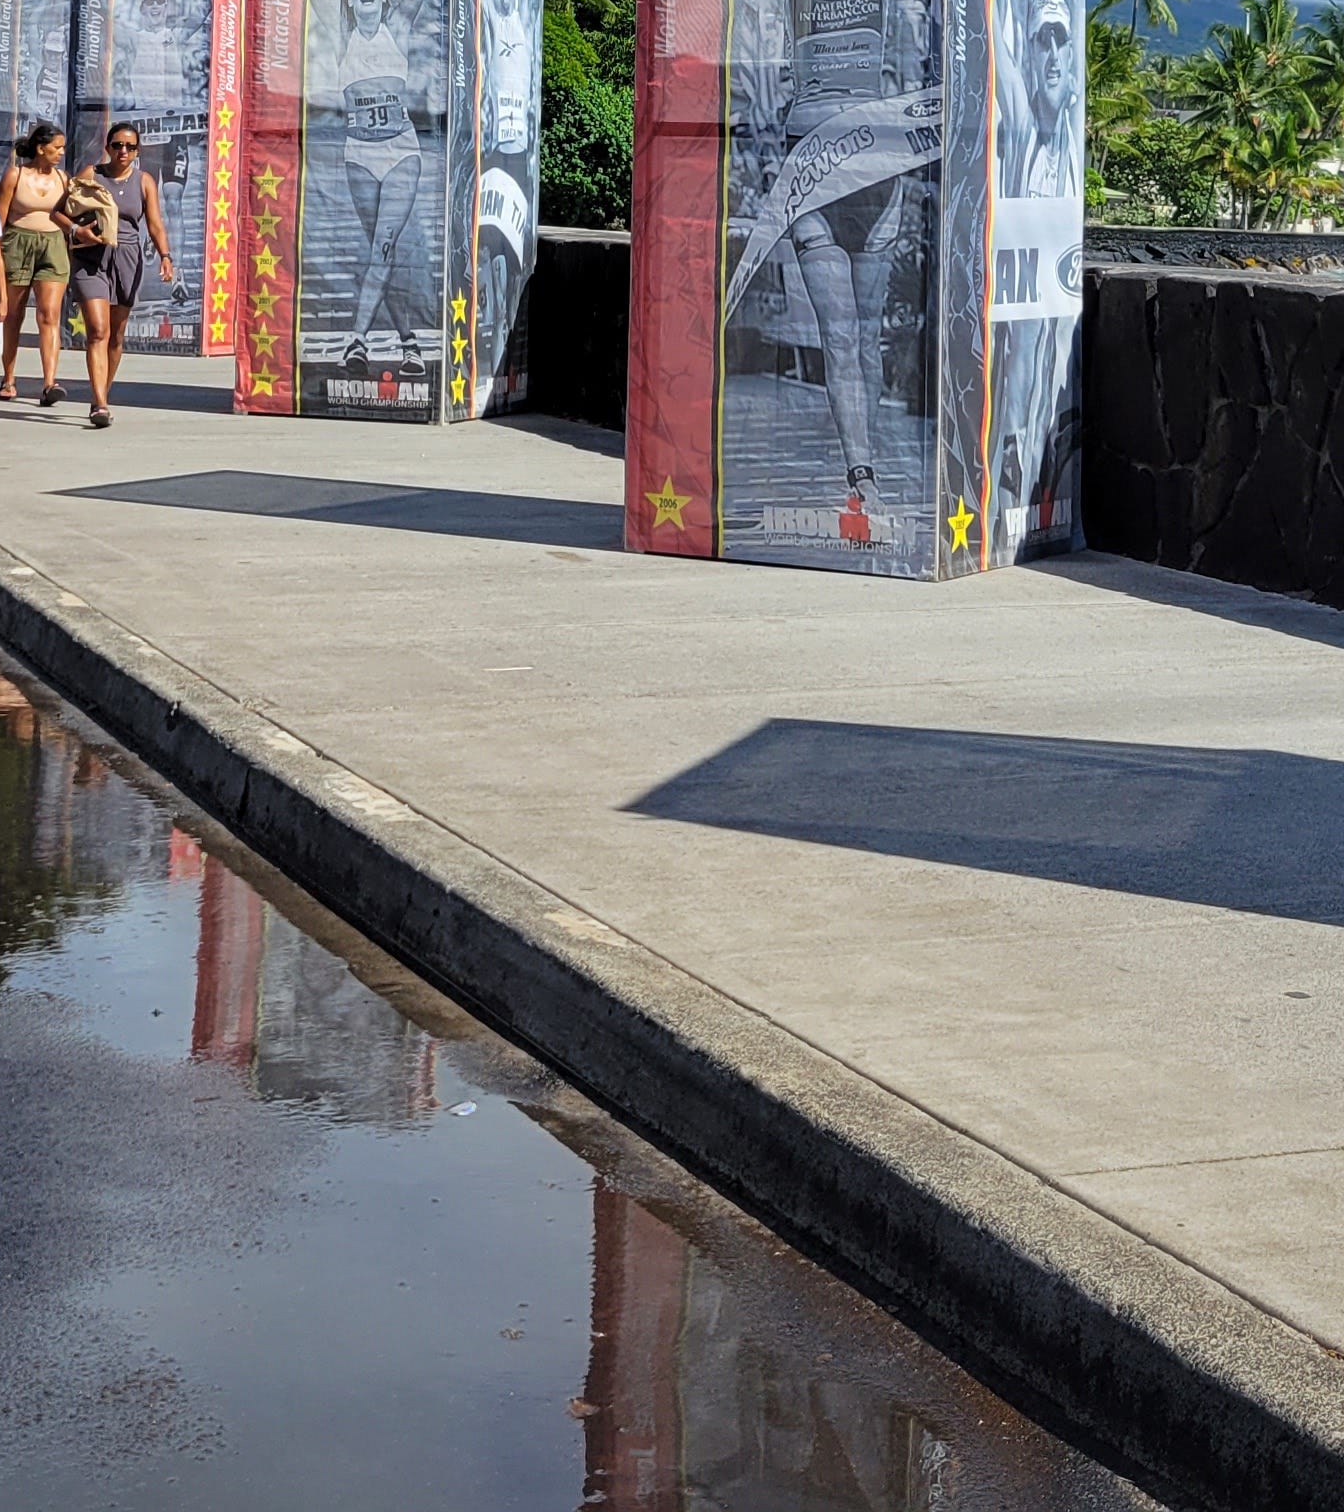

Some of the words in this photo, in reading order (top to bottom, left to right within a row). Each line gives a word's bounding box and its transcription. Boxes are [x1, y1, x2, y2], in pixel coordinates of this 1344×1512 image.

[86, 13, 104, 68] Timothy
[225, 52, 236, 93] Paula
[455, 41, 466, 87] World
[366, 107, 389, 128] 39
[327, 378, 432, 401] IRONMAN
[328, 396, 358, 406] WORLD
[360, 398, 429, 408] CHAMPIONSHIP
[658, 497, 678, 509] 2006
[762, 505, 917, 545] IRONMAN
[813, 539, 917, 557] CHAMPIONSHIP
